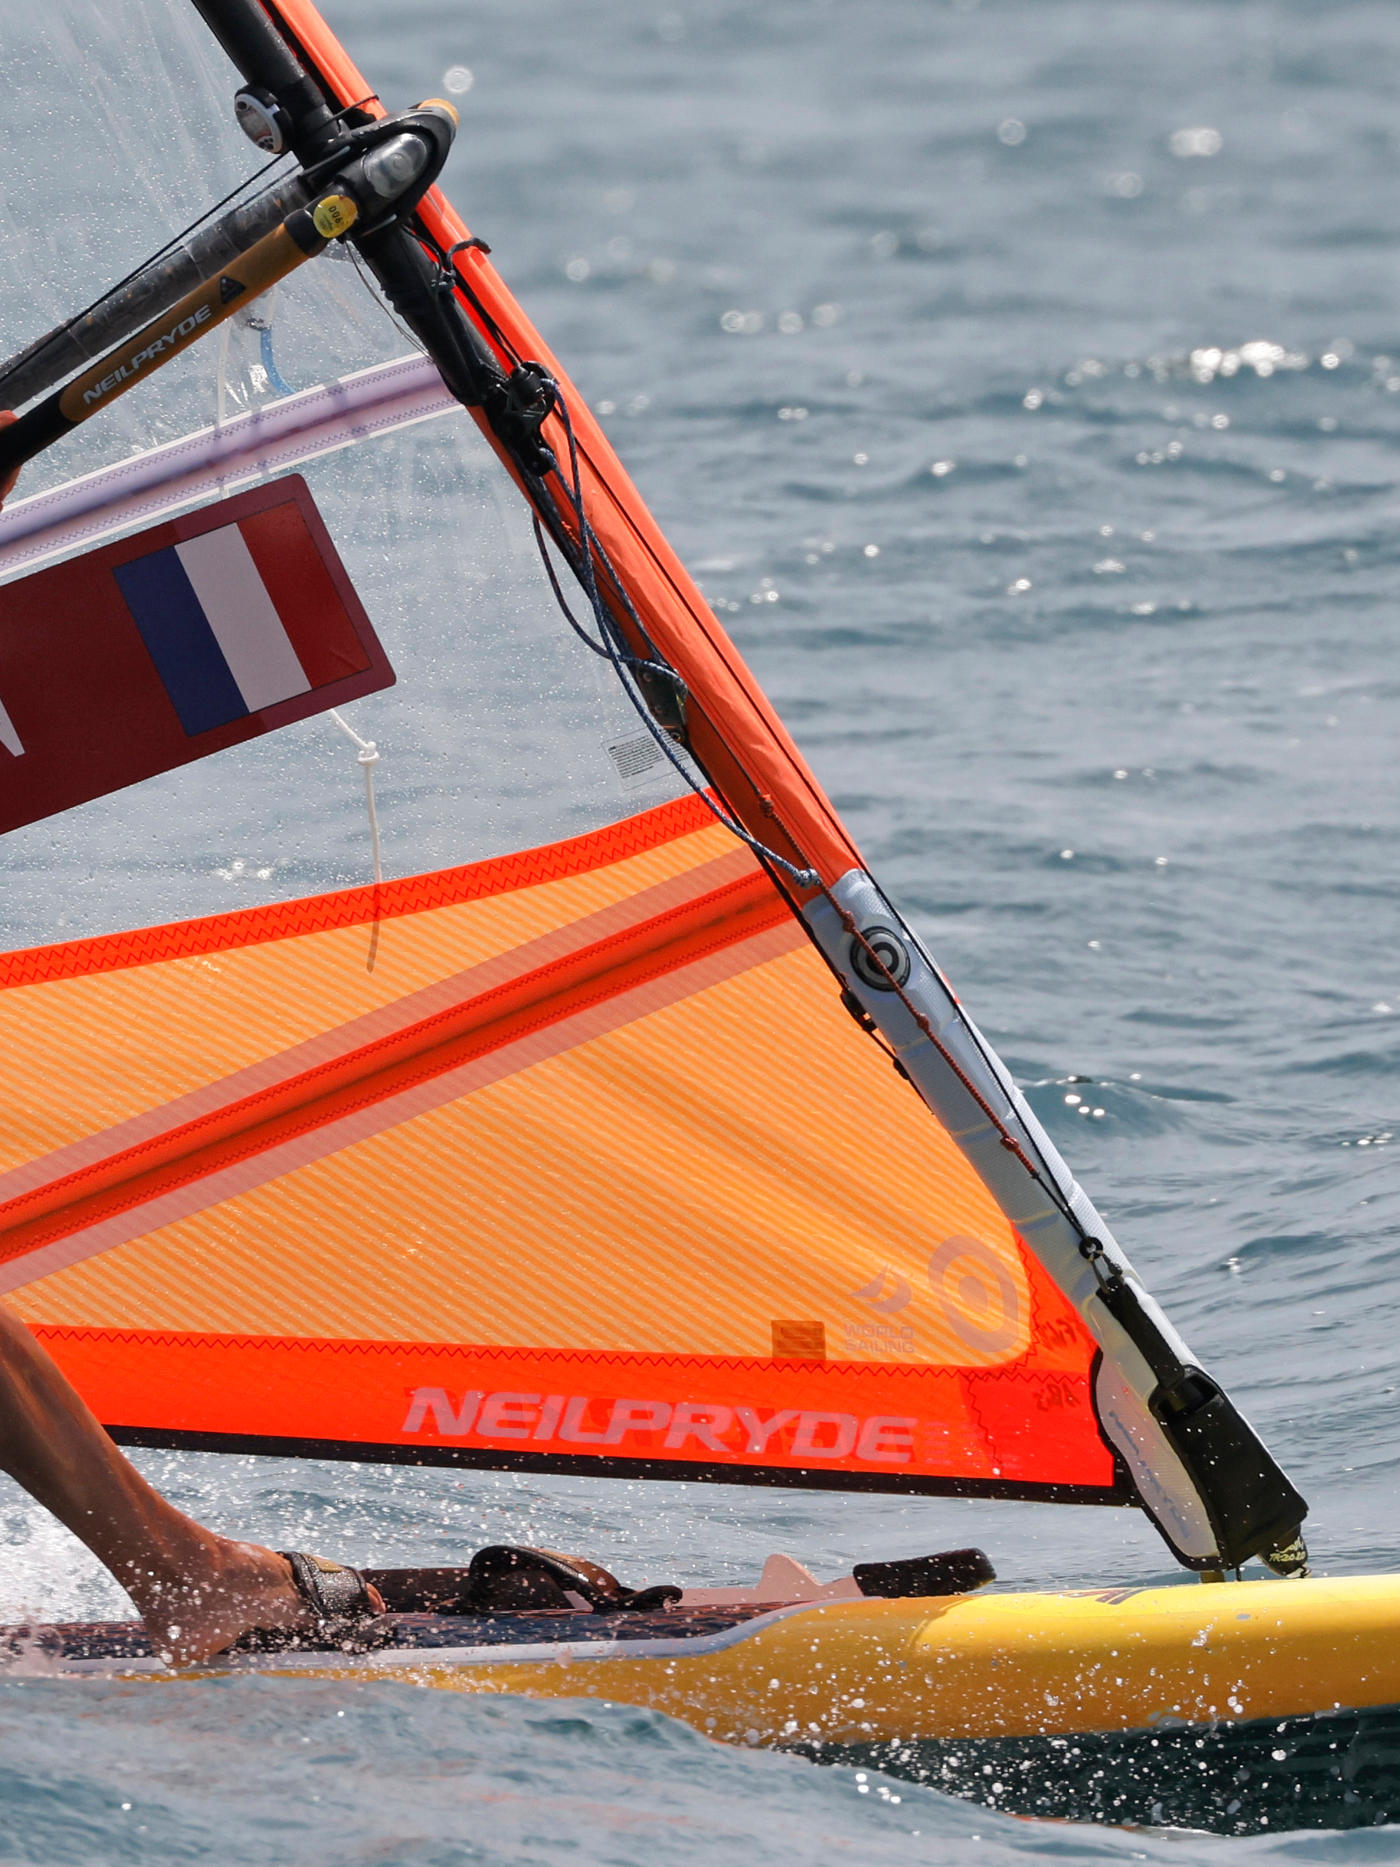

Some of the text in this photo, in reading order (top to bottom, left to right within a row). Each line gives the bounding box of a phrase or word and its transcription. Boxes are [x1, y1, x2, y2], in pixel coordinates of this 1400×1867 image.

[82, 304, 212, 405] NEILPRYDE
[844, 1322, 914, 1340] WORLD
[845, 1338, 915, 1354] SAILING
[401, 1386, 917, 1463] NEILPRYDE
